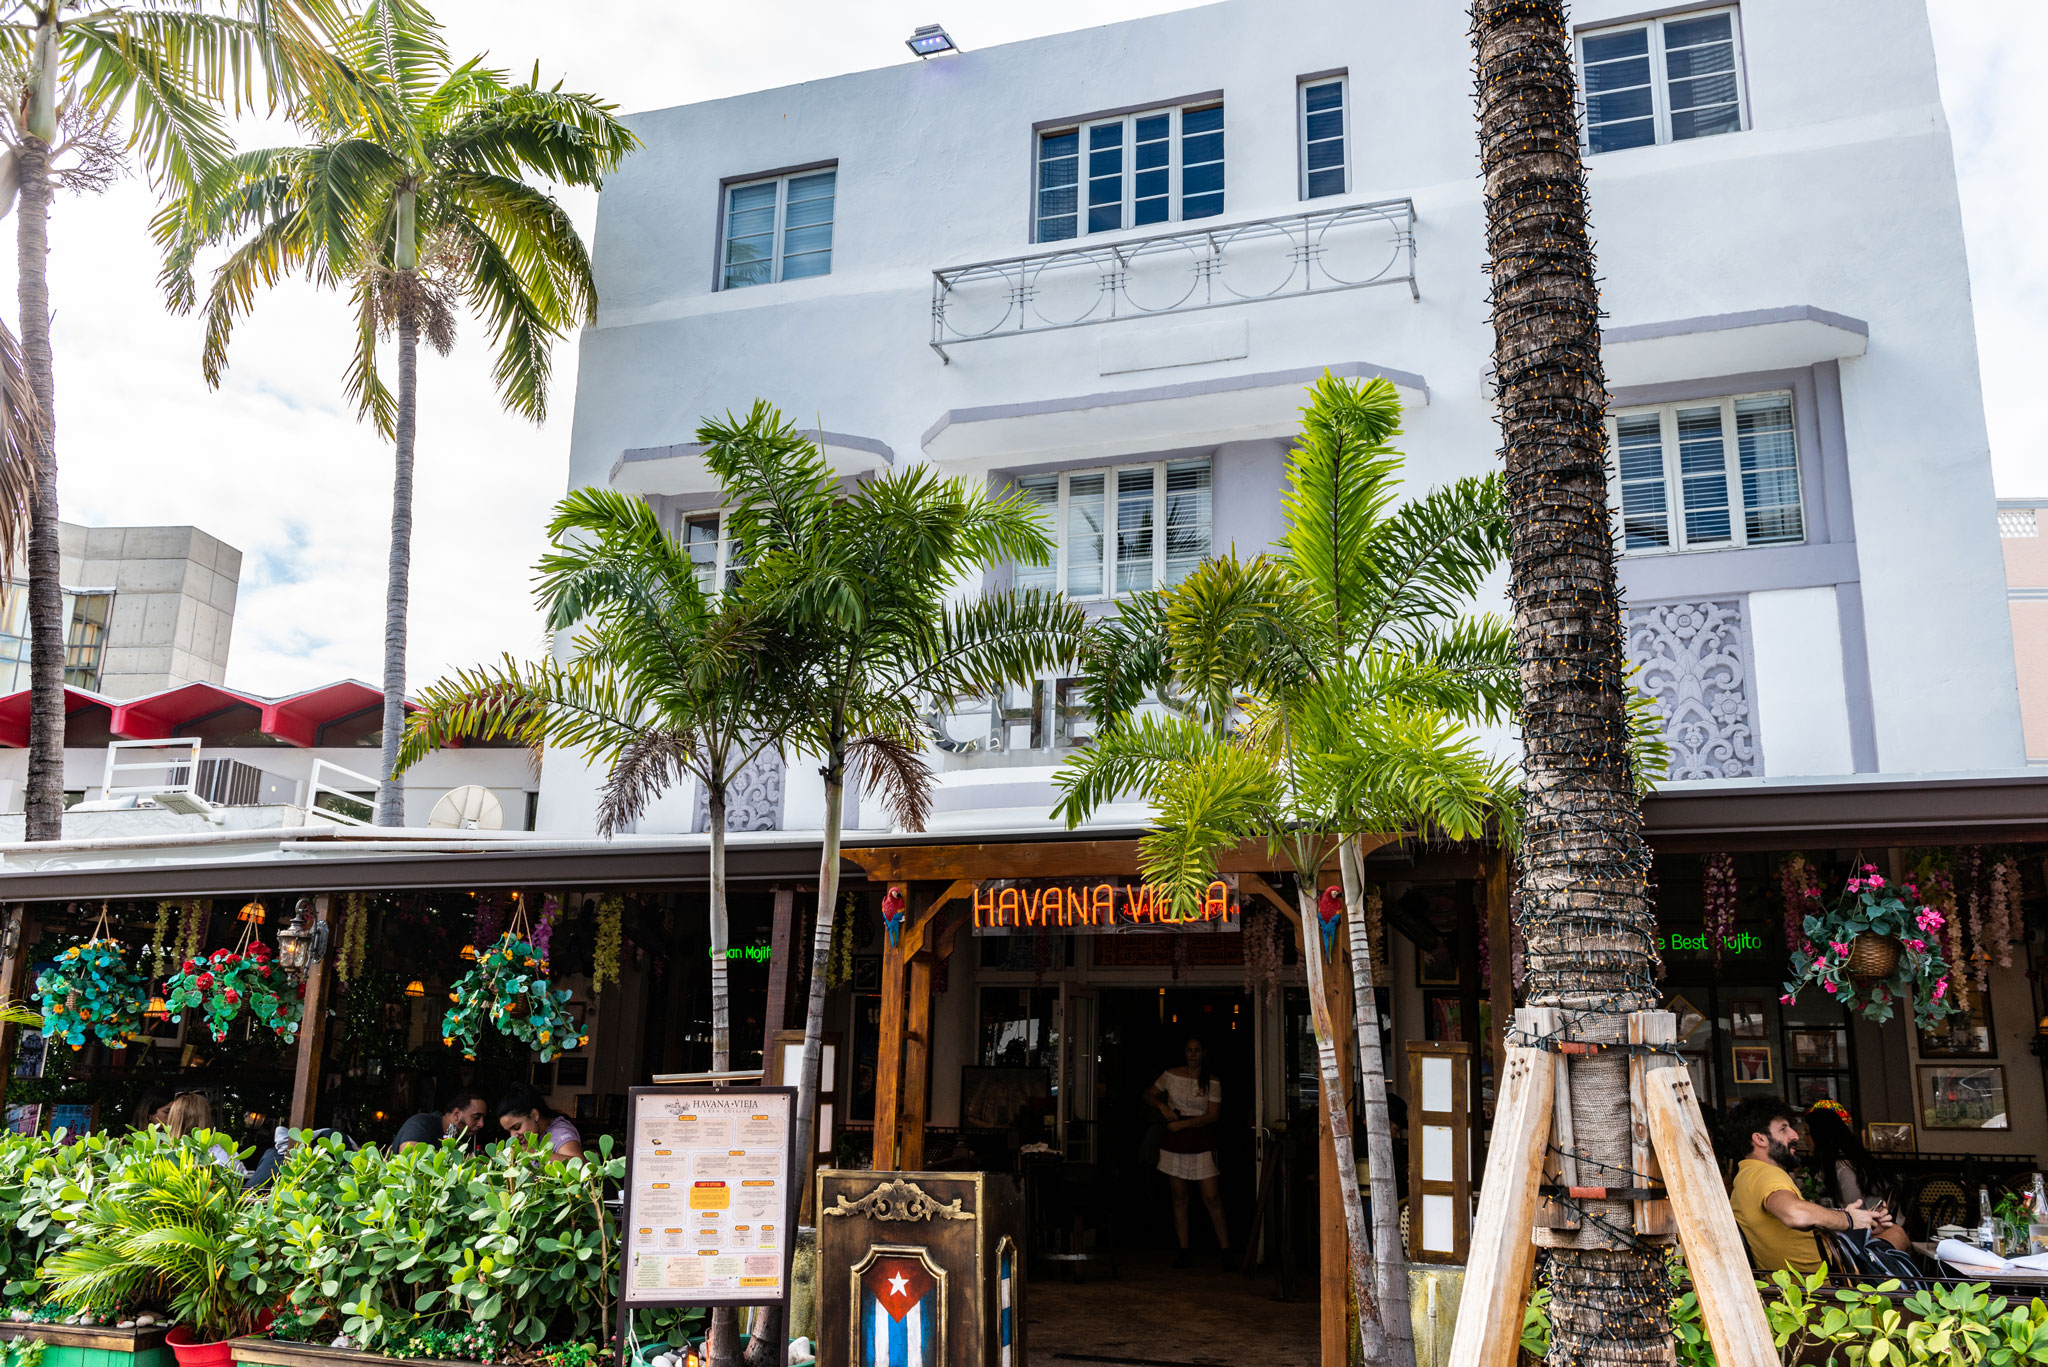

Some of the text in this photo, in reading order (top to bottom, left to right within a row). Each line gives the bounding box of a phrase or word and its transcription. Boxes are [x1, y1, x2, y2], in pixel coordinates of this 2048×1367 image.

[974, 884, 1115, 928] HAVANA
[1671, 932, 1709, 950] Best
[1722, 931, 1762, 955] ojito
[745, 945, 772, 963] Mojit
[693, 1100, 758, 1109] HAVANA VIEJA
